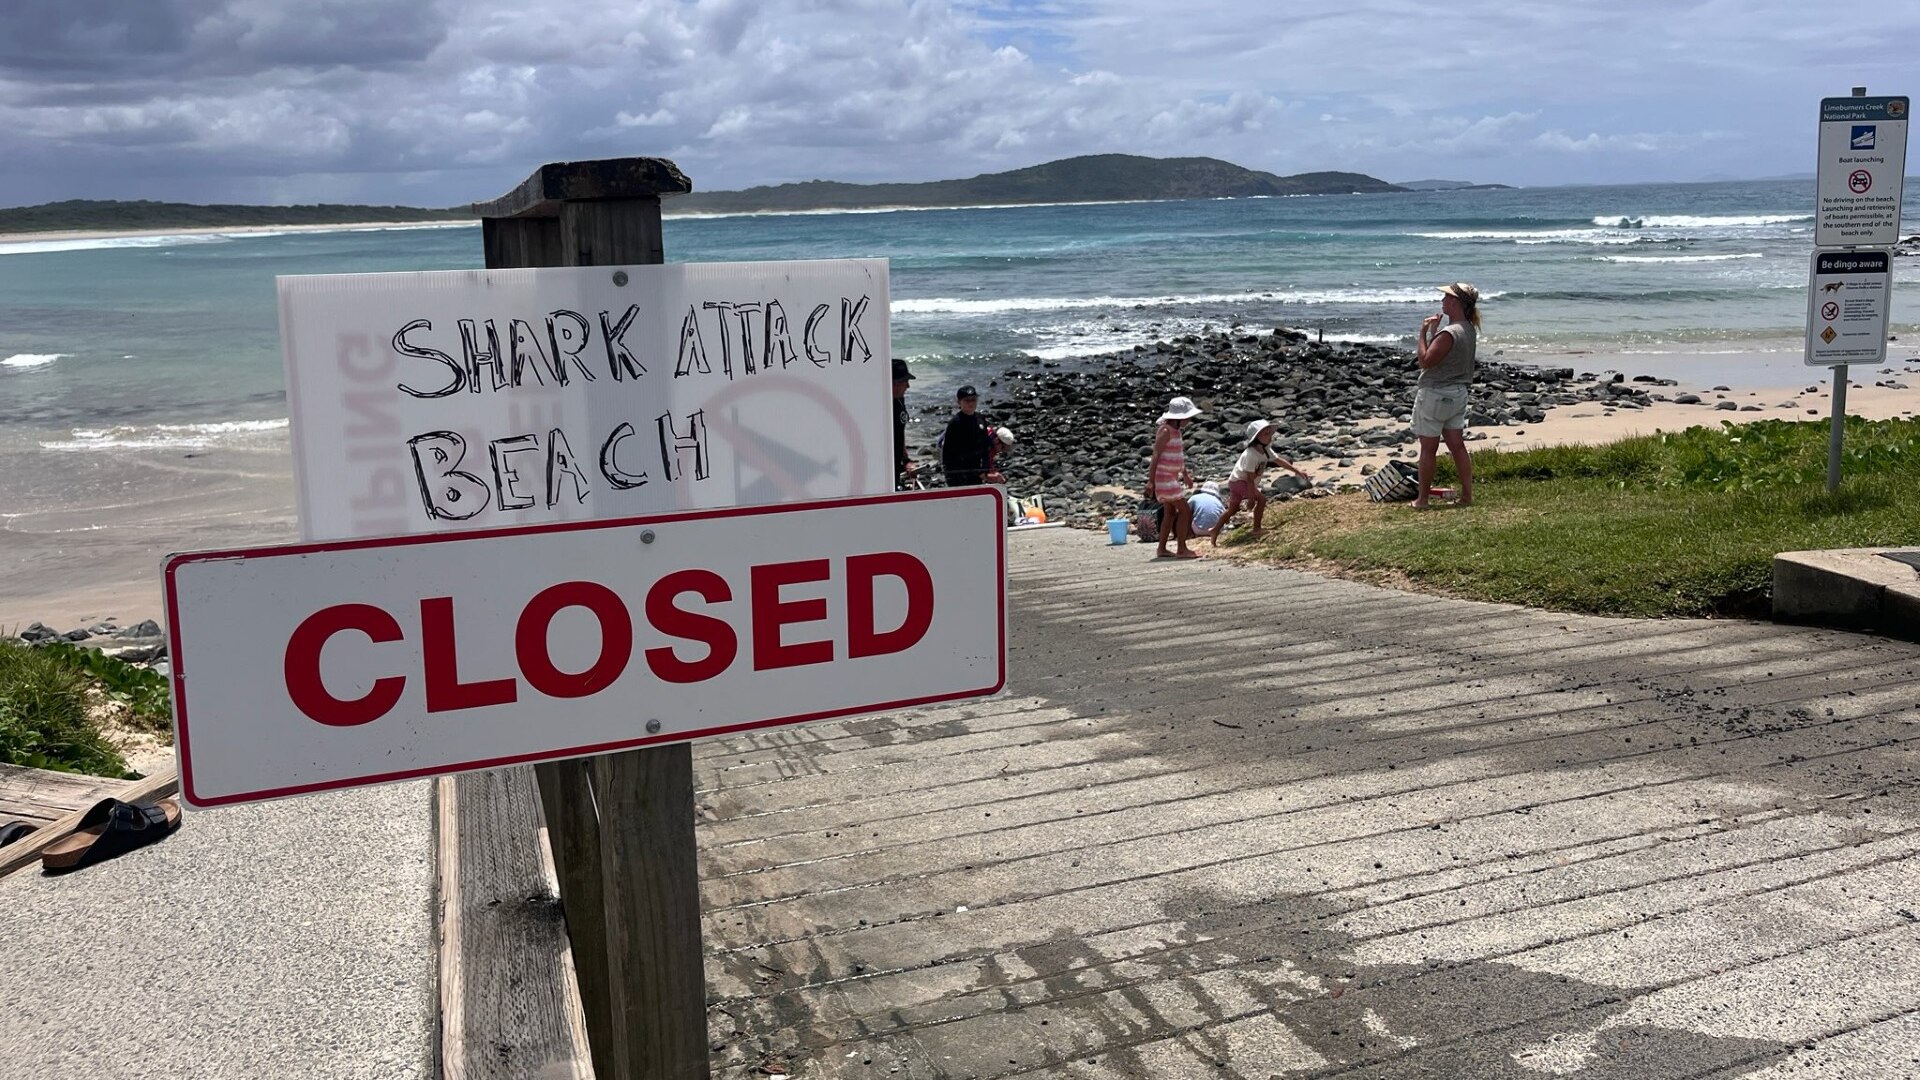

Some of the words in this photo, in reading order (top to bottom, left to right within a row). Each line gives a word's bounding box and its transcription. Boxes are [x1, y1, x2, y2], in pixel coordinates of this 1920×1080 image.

[1853, 156, 1884, 164] launching
[1821, 260, 1833, 269] Be
[1833, 260, 1858, 270] dingo
[1858, 260, 1884, 268] aware
[391, 303, 647, 399] SHARK
[673, 295, 873, 380] ATTACK
[406, 408, 711, 521] BEACH
[283, 551, 935, 728] CLOSED
